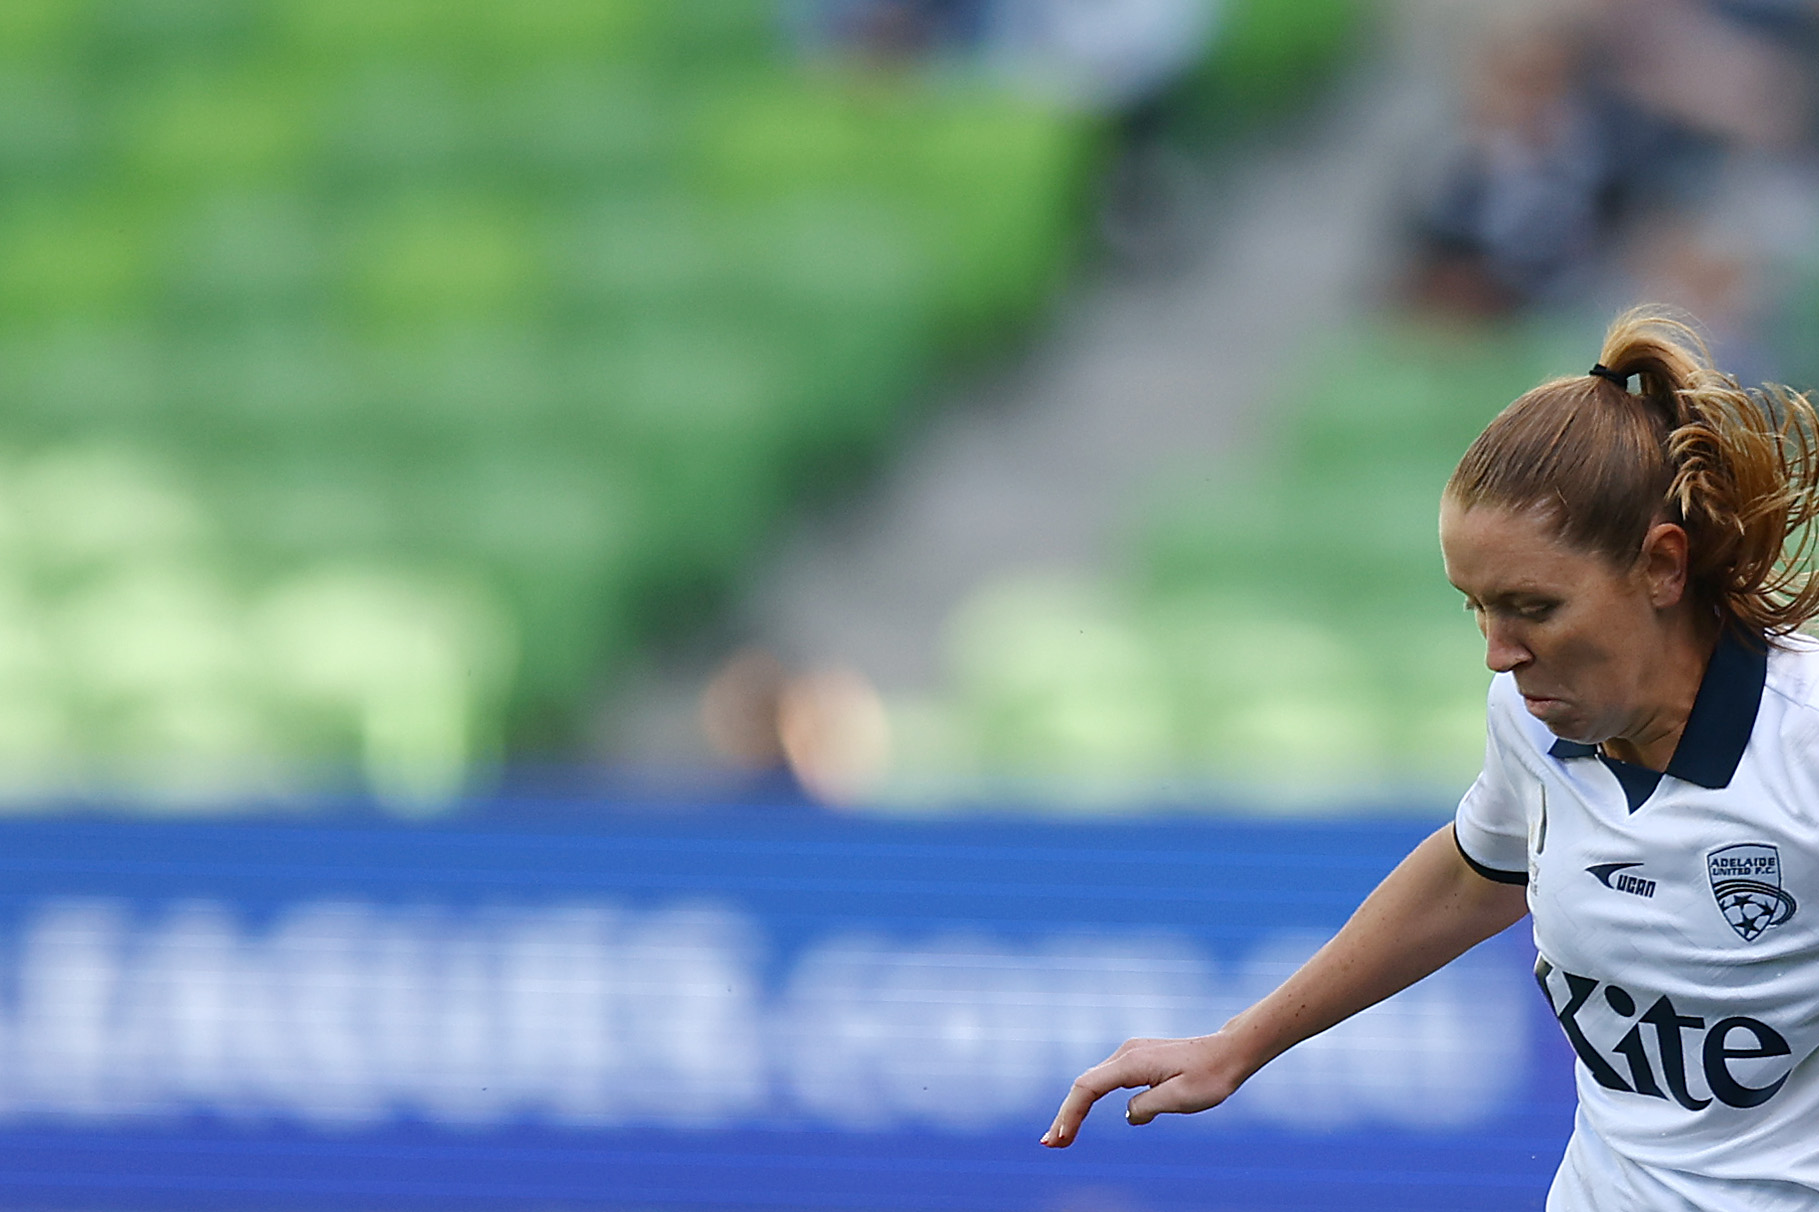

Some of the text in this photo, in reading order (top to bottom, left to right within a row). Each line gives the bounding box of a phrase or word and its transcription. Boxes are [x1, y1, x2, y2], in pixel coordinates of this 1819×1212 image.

[1711, 857, 1776, 868] ADELAIDE
[1712, 867, 1751, 876] UNITED
[1534, 955, 1792, 1111] Kite
